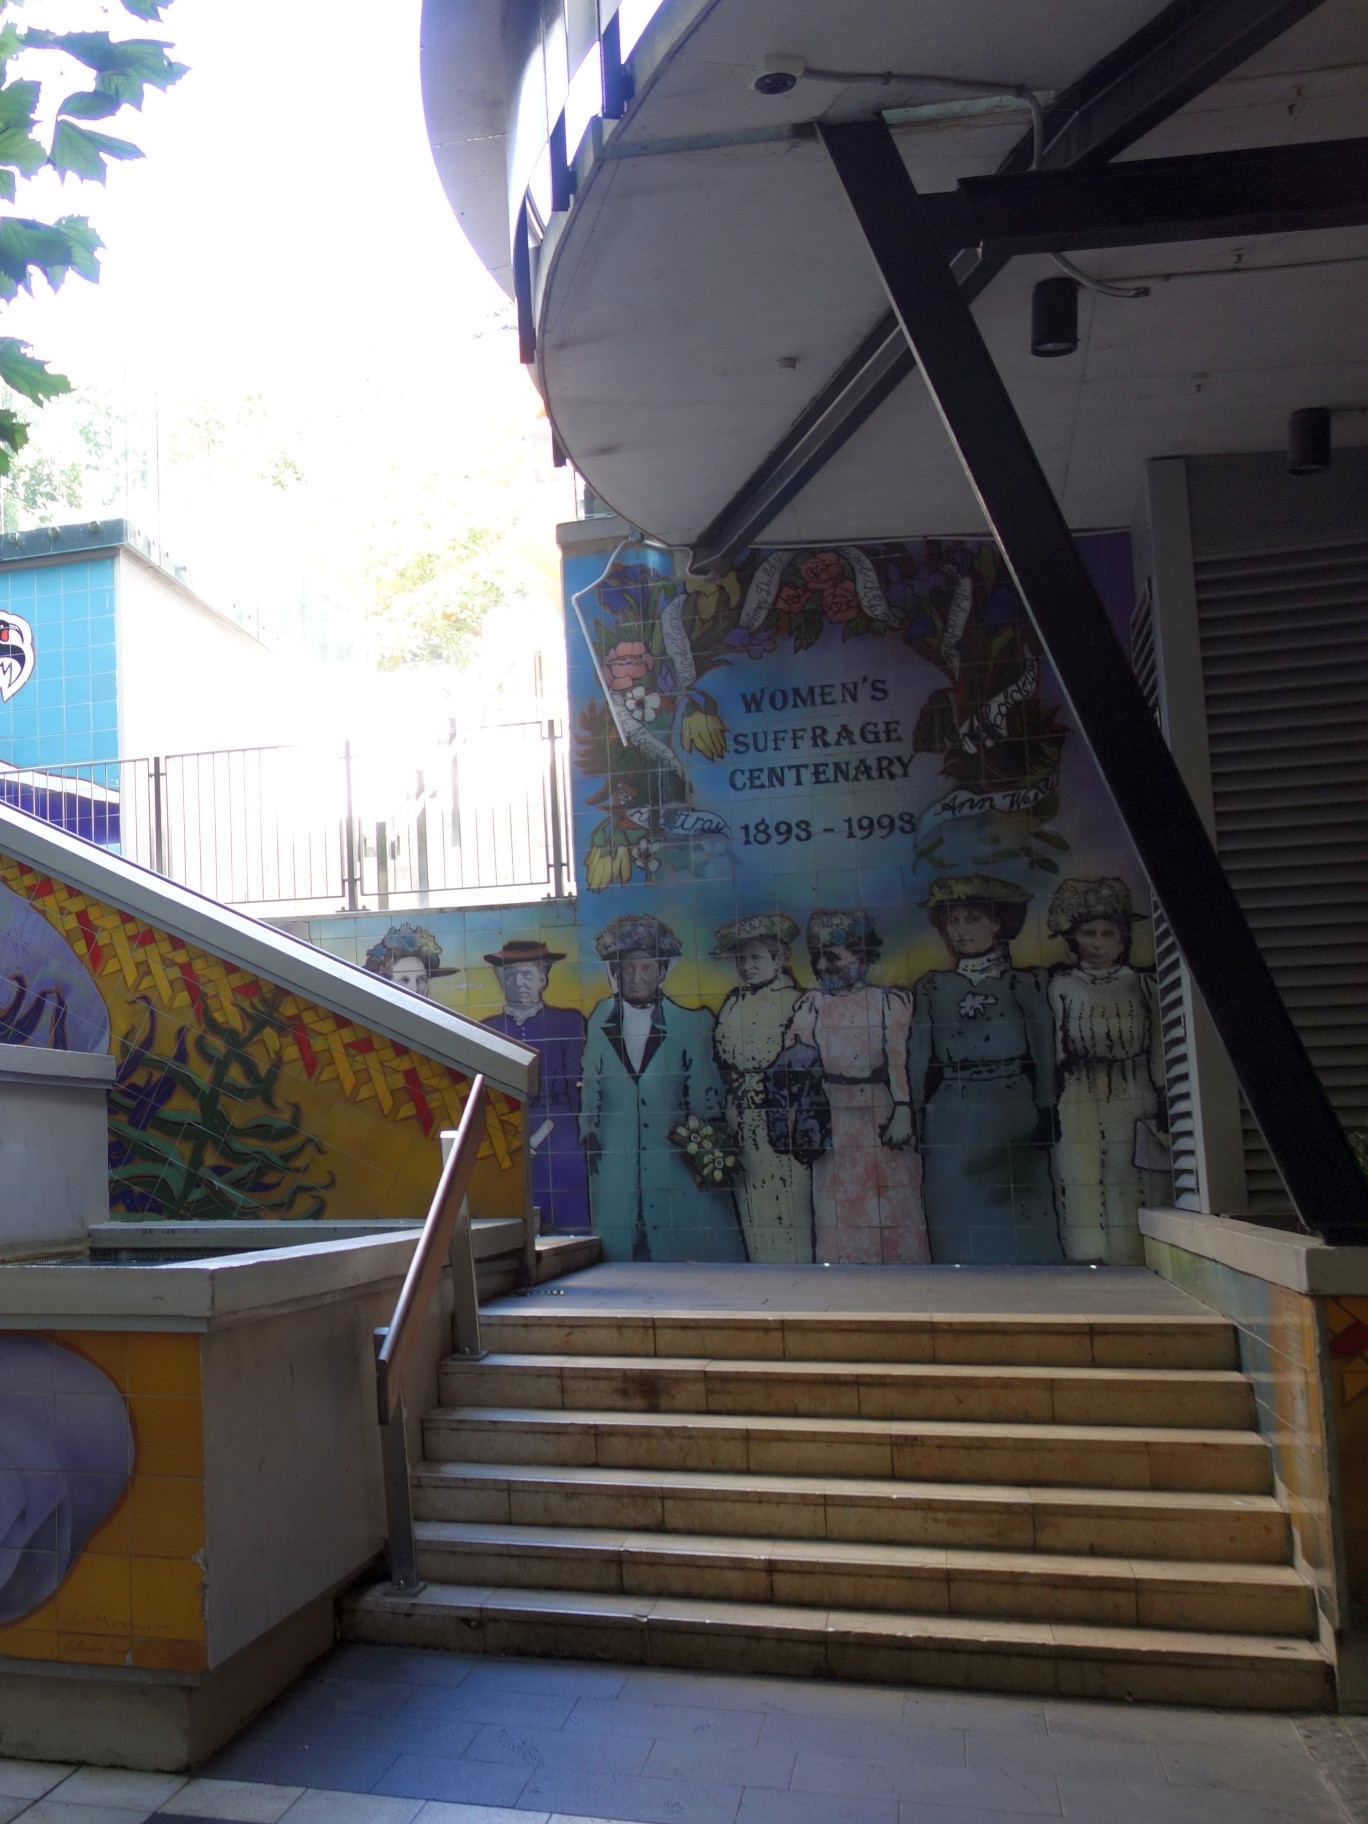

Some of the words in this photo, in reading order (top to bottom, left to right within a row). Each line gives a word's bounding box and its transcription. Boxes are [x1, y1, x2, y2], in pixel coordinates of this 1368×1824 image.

[739, 676, 889, 714] WOMEN'S
[732, 721, 903, 755] SUFFRAGE
[729, 755, 915, 792] CENTENARY
[741, 816, 813, 846] 1893
[844, 811, 917, 840] 1993
